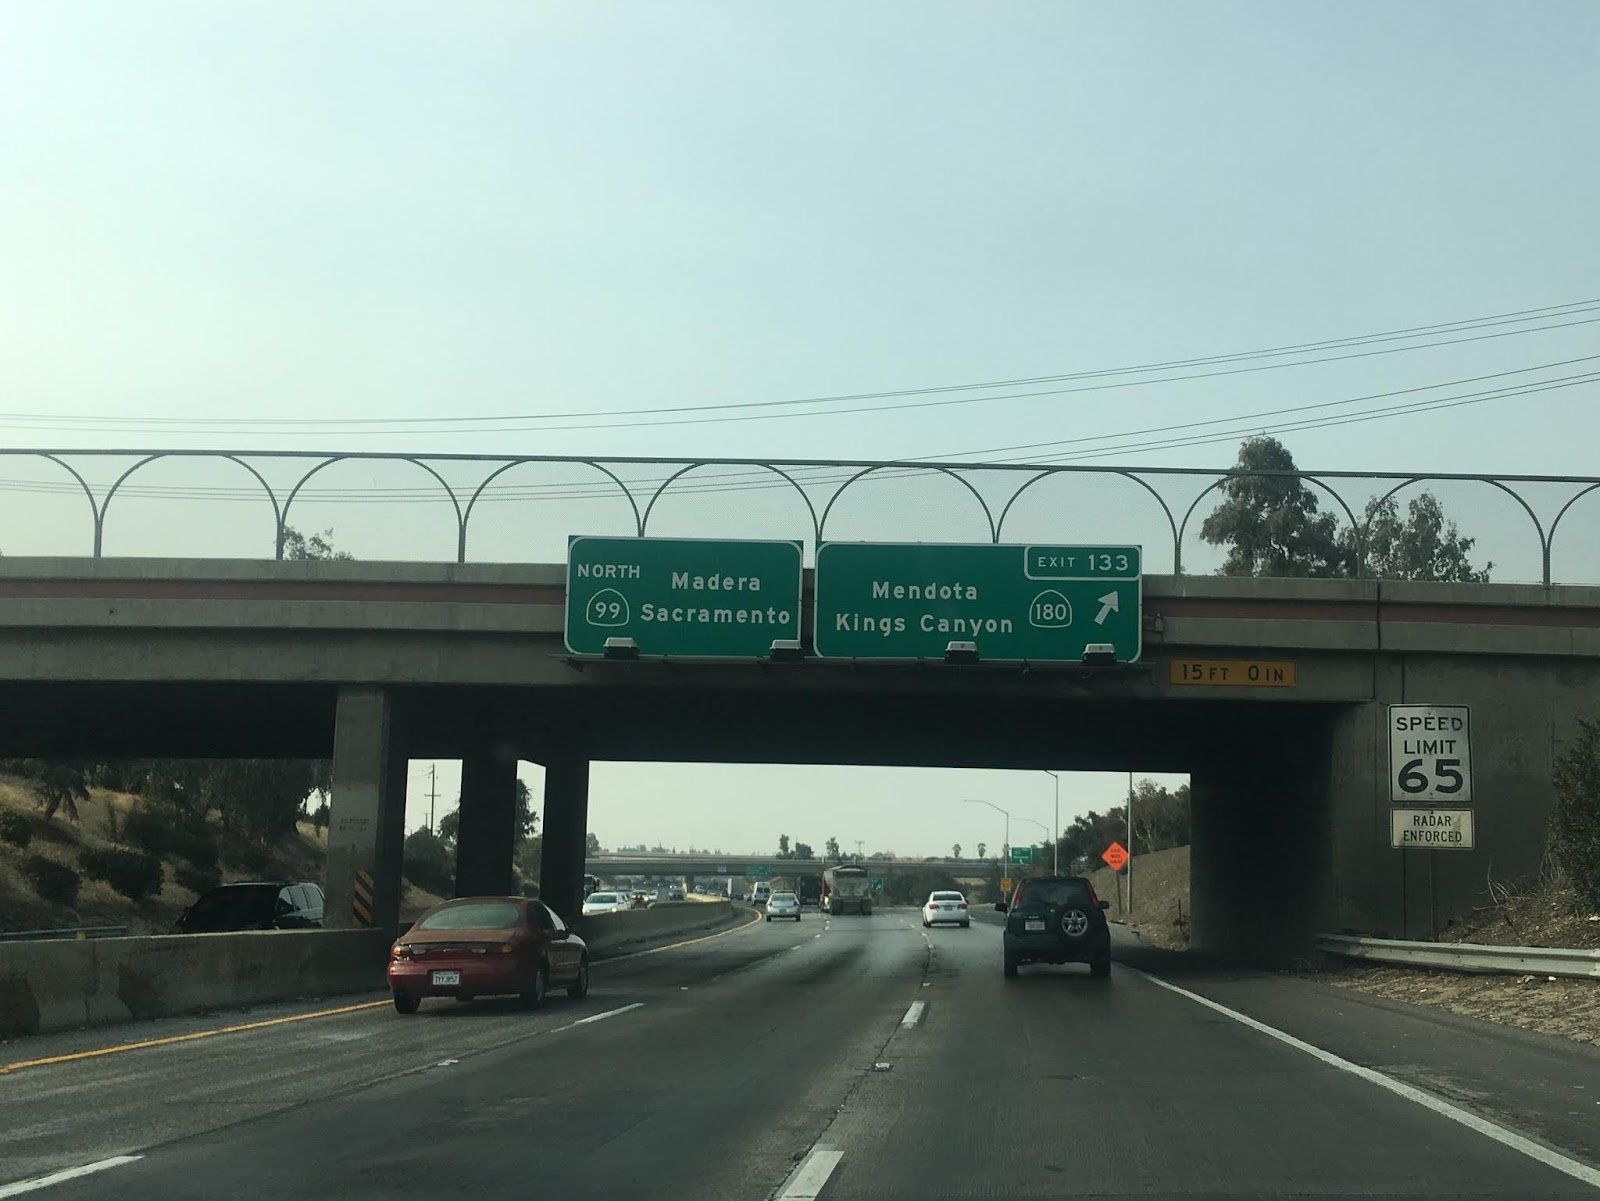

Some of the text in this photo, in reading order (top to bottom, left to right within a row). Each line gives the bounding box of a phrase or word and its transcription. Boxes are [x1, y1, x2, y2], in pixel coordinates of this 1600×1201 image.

[1038, 554, 1129, 571] EXIT 133
[577, 564, 640, 579] NORTH
[672, 572, 760, 591] Madera
[872, 581, 978, 600] Mendota
[595, 602, 621, 619] 99
[641, 604, 791, 624] Sacramento
[1035, 603, 1067, 621] 180
[836, 614, 1013, 637] Kings Canyon
[1396, 716, 1463, 731] SPEED
[1404, 739, 1456, 755] LIMIT
[1398, 759, 1464, 794] 65
[1413, 815, 1452, 827] RADAR
[1403, 830, 1463, 843] ENFORCED
